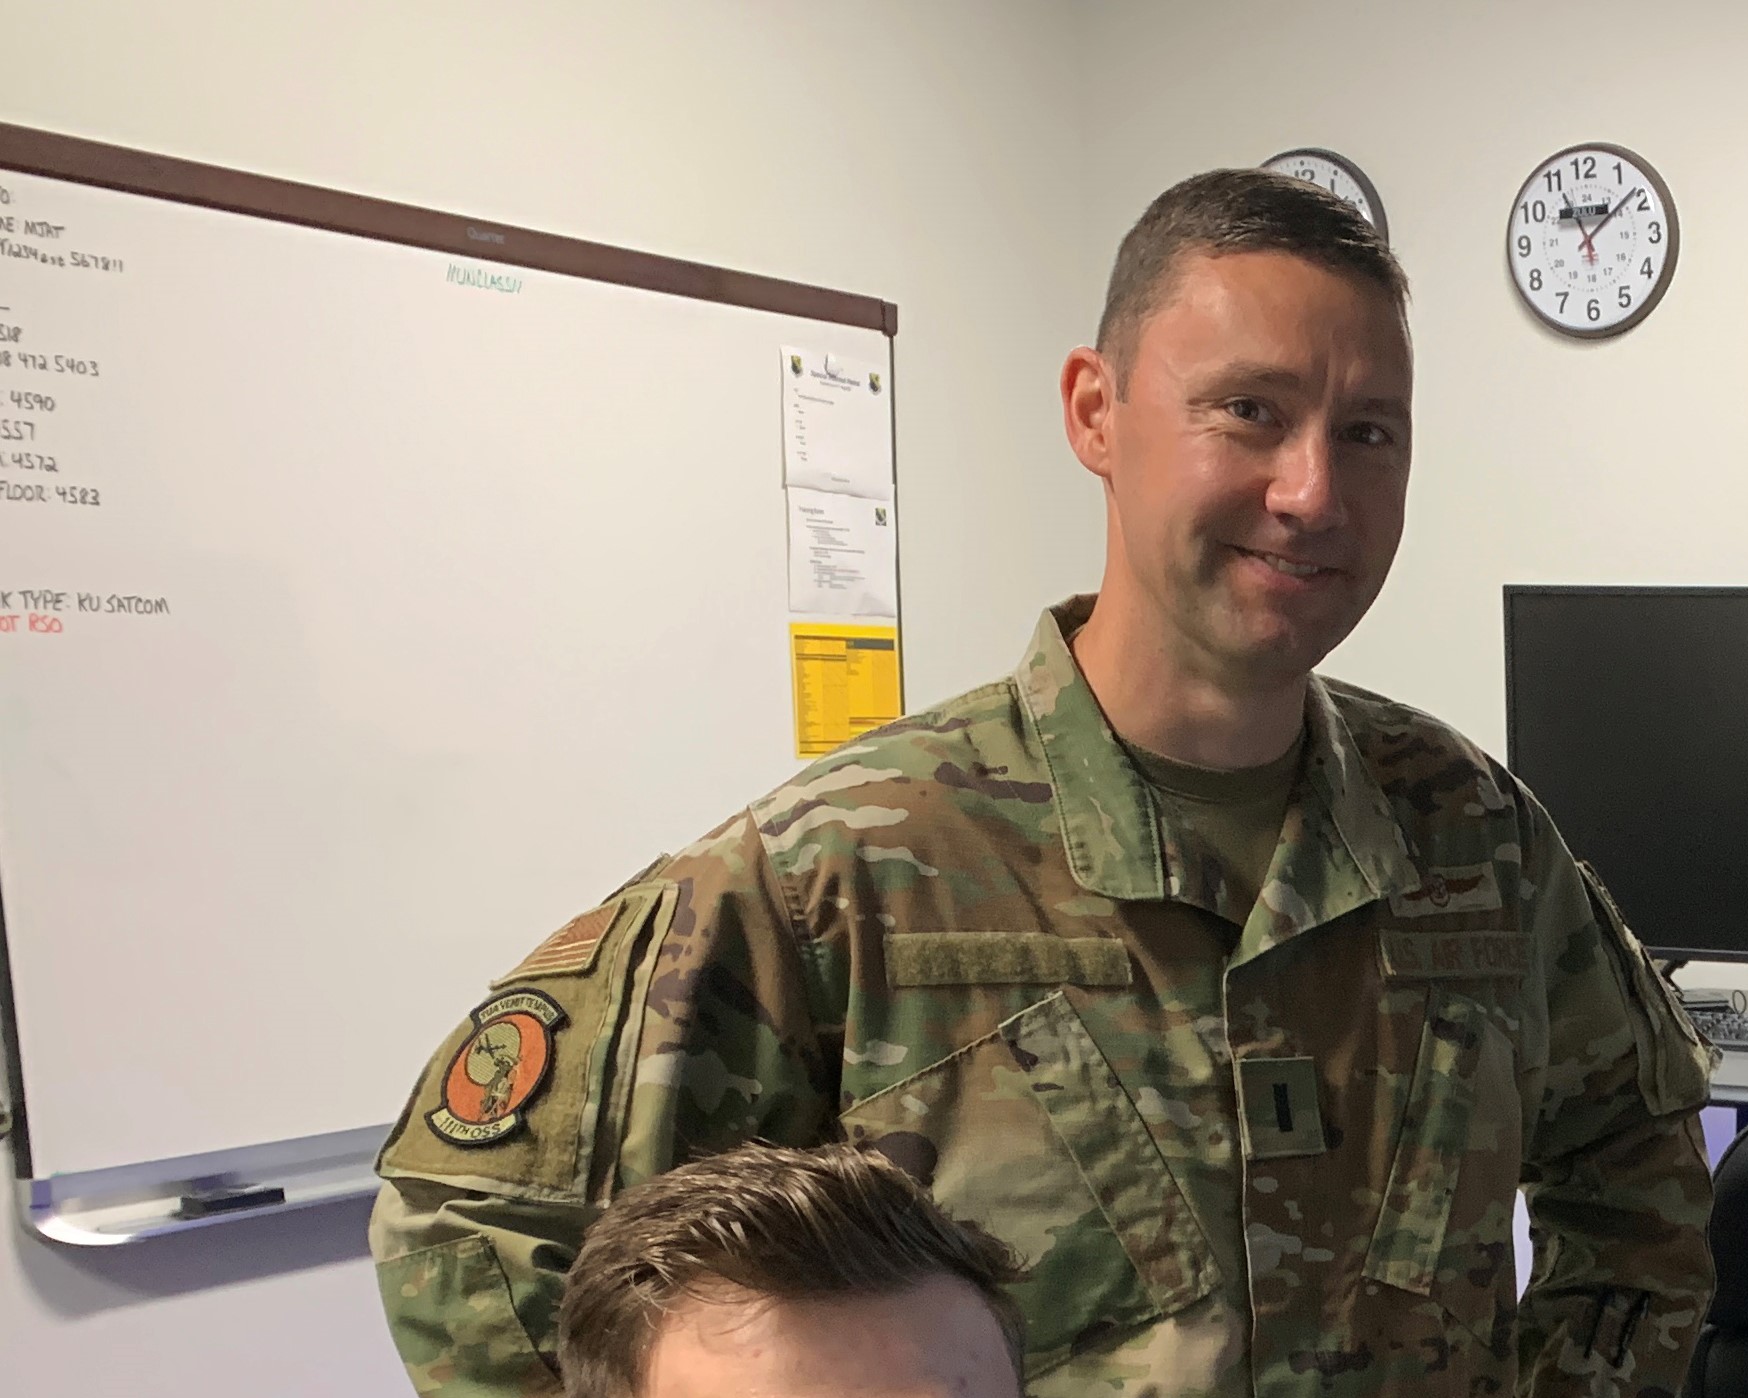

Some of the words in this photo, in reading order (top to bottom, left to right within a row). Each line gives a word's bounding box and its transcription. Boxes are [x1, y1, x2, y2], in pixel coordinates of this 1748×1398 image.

[1570, 156, 1597, 180] 12
[1612, 162, 1623, 184] 1
[1543, 169, 1562, 192] 11
[1636, 188, 1650, 211] 2
[1521, 200, 1546, 224] 10
[1648, 221, 1661, 244] 3
[1518, 235, 1531, 257] 9
[1529, 268, 1543, 291] 8
[1640, 257, 1654, 280] 4
[1555, 291, 1569, 314] 7
[1618, 285, 1632, 308] 5
[1587, 299, 1600, 321] 6
[54, 354, 100, 377] 5403
[9, 389, 56, 412] 4590
[12, 452, 59, 473] 4572
[56, 485, 100, 506] 4583
[105, 594, 171, 615] SATCOM
[470, 1123, 501, 1138] OSS
